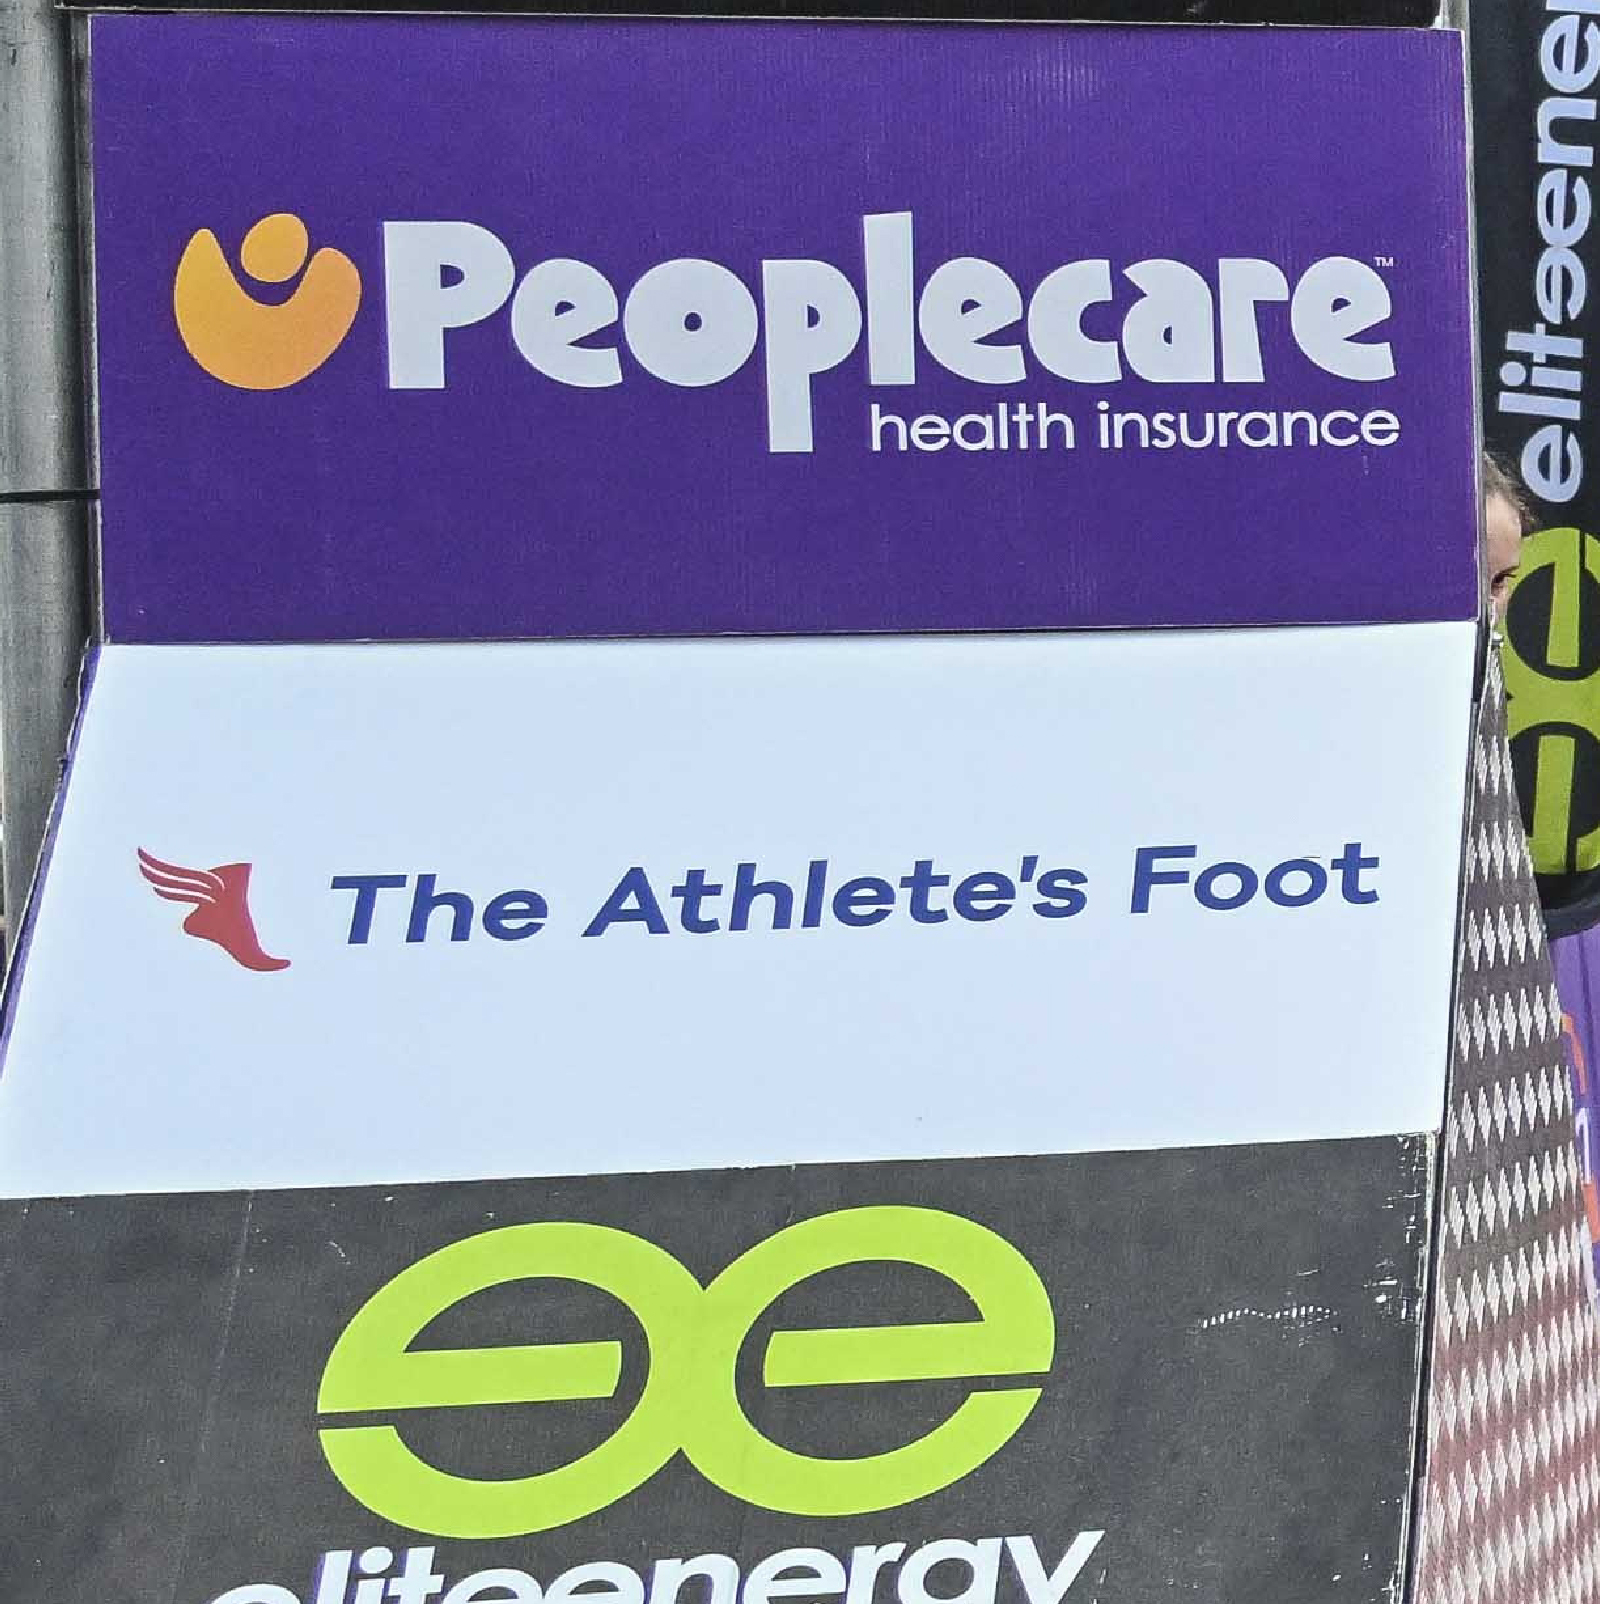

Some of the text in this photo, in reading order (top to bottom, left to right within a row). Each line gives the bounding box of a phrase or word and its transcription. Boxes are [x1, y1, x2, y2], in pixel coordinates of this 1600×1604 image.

[383, 210, 1397, 453] Peoplecare
[872, 399, 1400, 452] health insurance
[330, 842, 1381, 945] The Athlete's Foot
